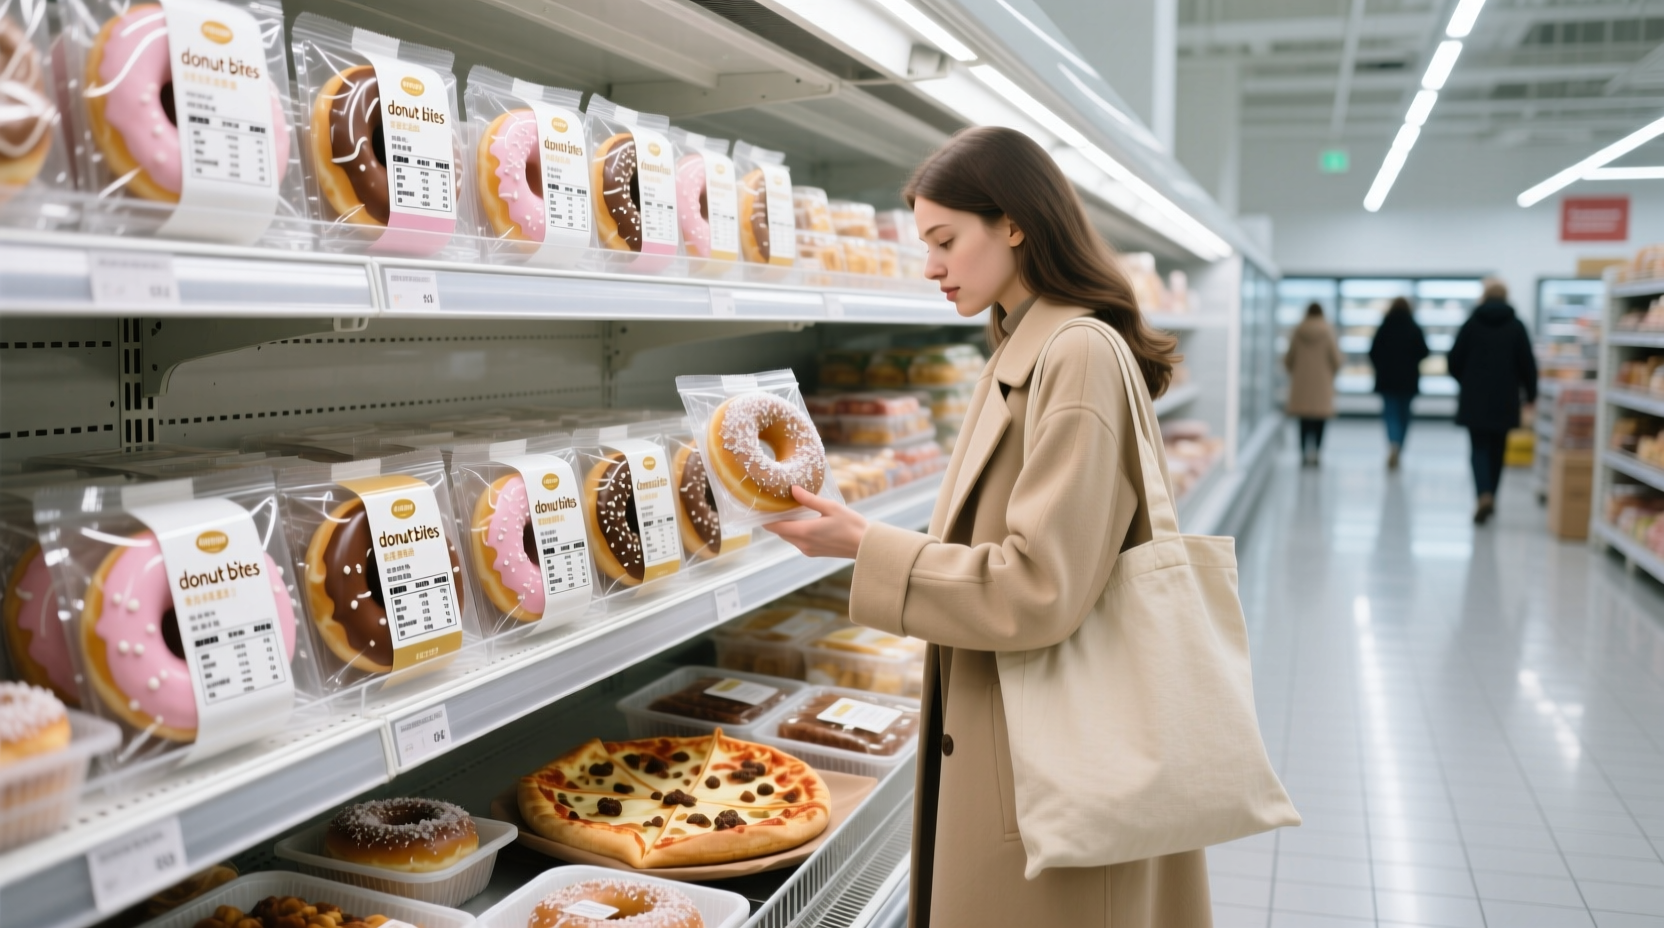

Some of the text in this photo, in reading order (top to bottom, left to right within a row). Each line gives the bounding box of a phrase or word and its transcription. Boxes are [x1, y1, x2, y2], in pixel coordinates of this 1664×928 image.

[181, 47, 224, 73] donut
[388, 100, 420, 120] donut
[179, 560, 260, 590] donut bites
